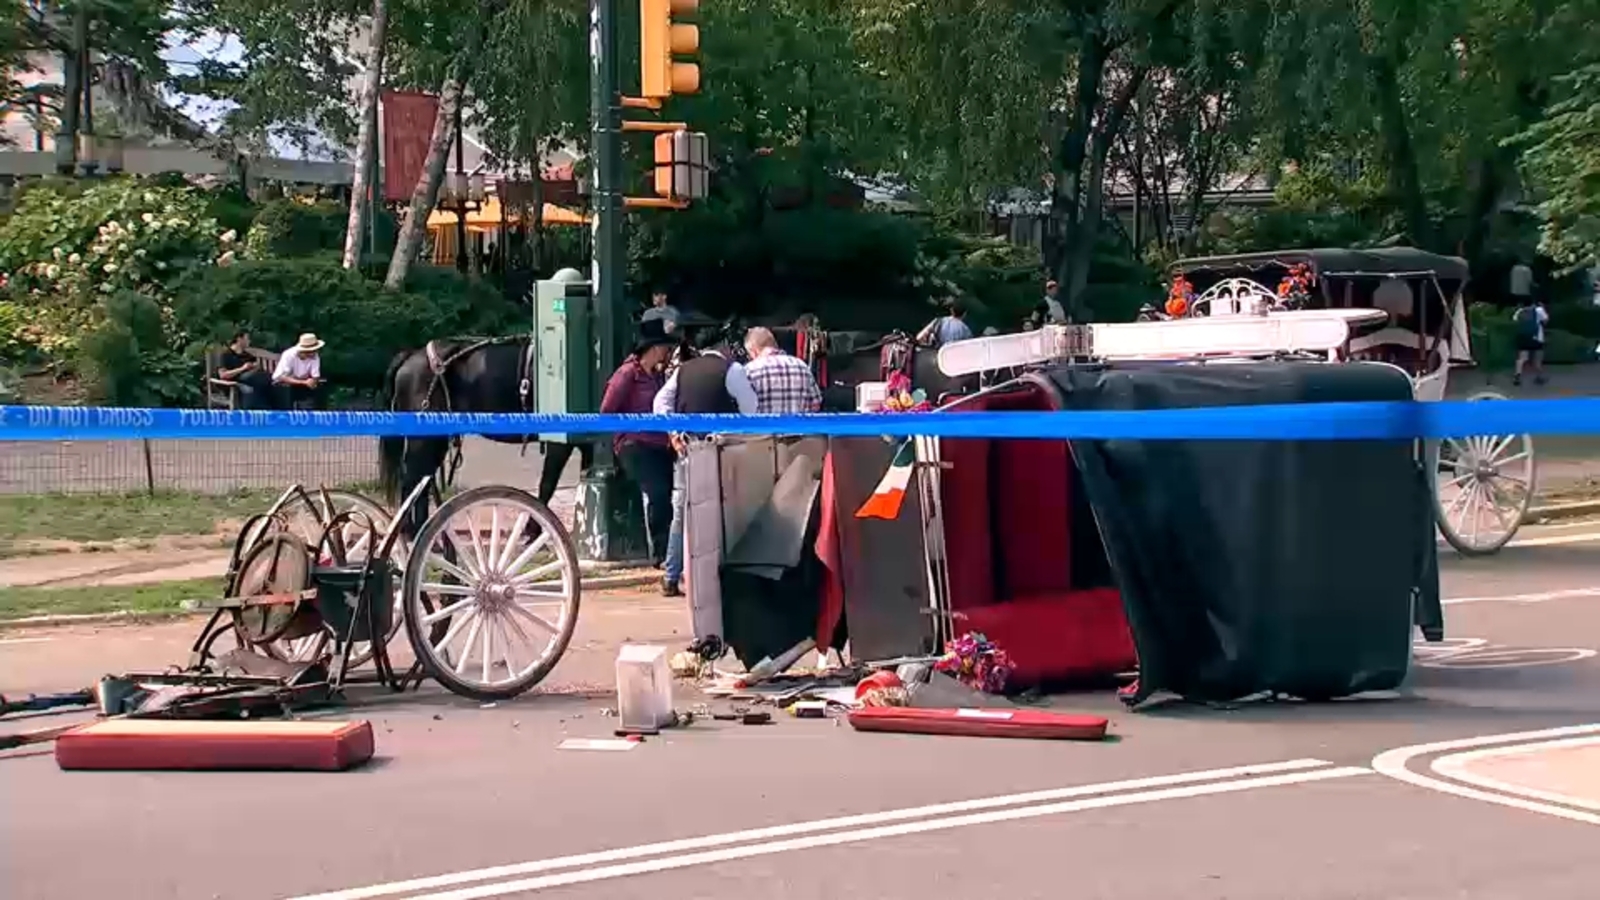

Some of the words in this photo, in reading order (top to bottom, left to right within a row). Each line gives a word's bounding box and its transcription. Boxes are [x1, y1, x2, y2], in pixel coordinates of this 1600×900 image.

[97, 406, 155, 427] CROSS
[180, 408, 235, 427] POLICE
[240, 409, 273, 426] LINE
